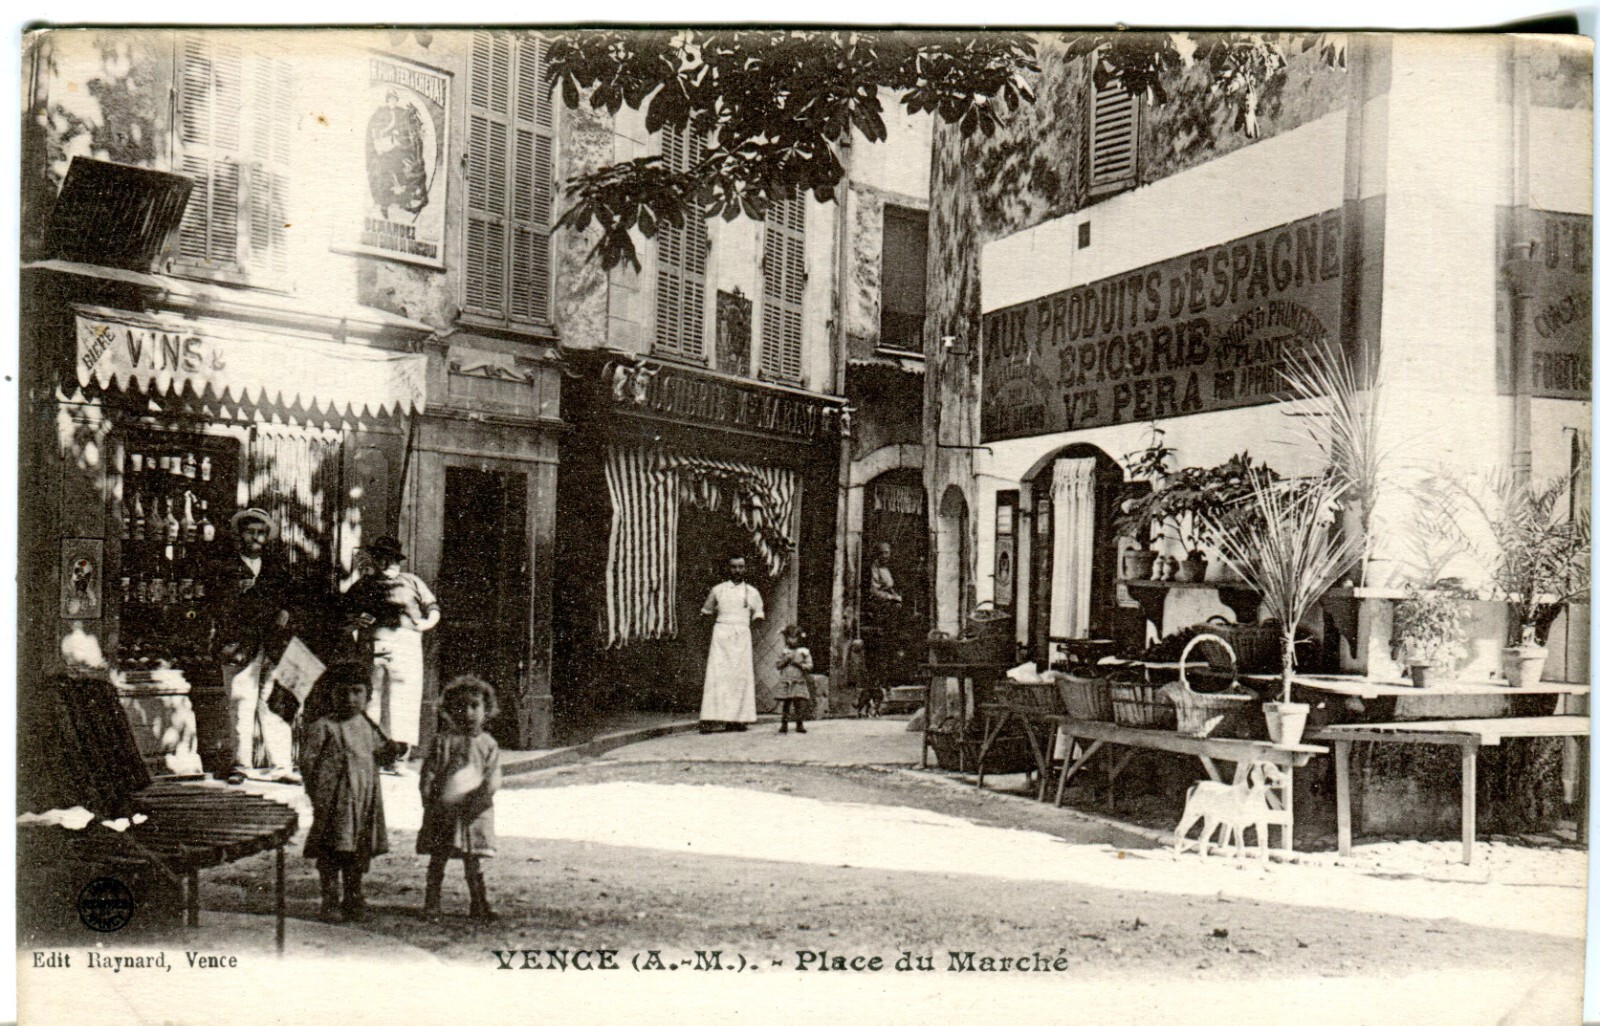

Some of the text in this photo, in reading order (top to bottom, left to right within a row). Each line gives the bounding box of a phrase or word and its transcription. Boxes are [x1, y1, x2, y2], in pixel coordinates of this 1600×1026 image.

[985, 307, 1030, 362] AUX
[1036, 270, 1162, 352] PRODUITS
[126, 329, 204, 374] VINS
[1058, 318, 1210, 388] EPICERIE
[1113, 372, 1205, 422] PERA
